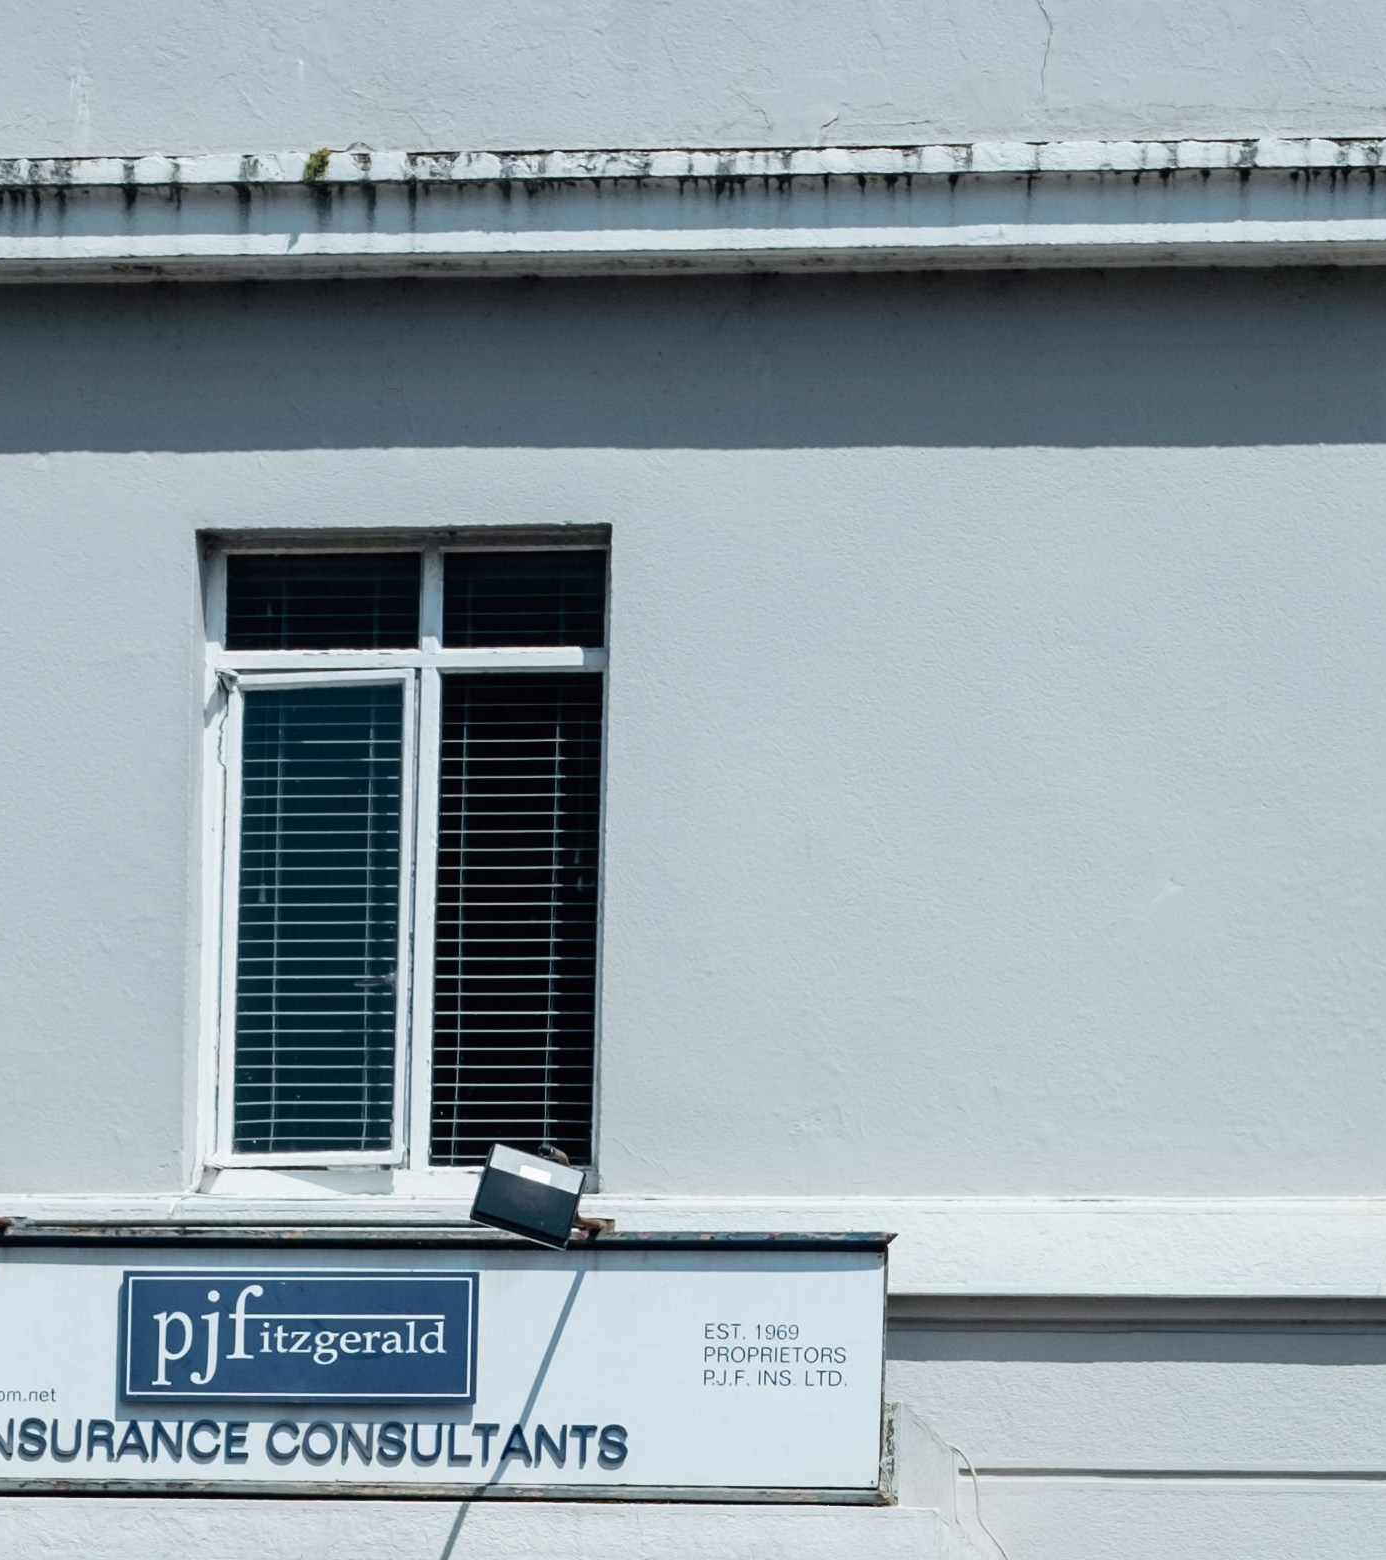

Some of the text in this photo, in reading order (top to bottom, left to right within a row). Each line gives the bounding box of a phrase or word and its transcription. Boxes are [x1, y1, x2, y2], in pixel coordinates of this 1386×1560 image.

[704, 1322, 800, 1341] EST. 1969
[703, 1346, 848, 1364] PROPRIETORS
[703, 1369, 848, 1388] P.J.F. INS. LTD.
[265, 1419, 628, 1470] CONSULTANTS
